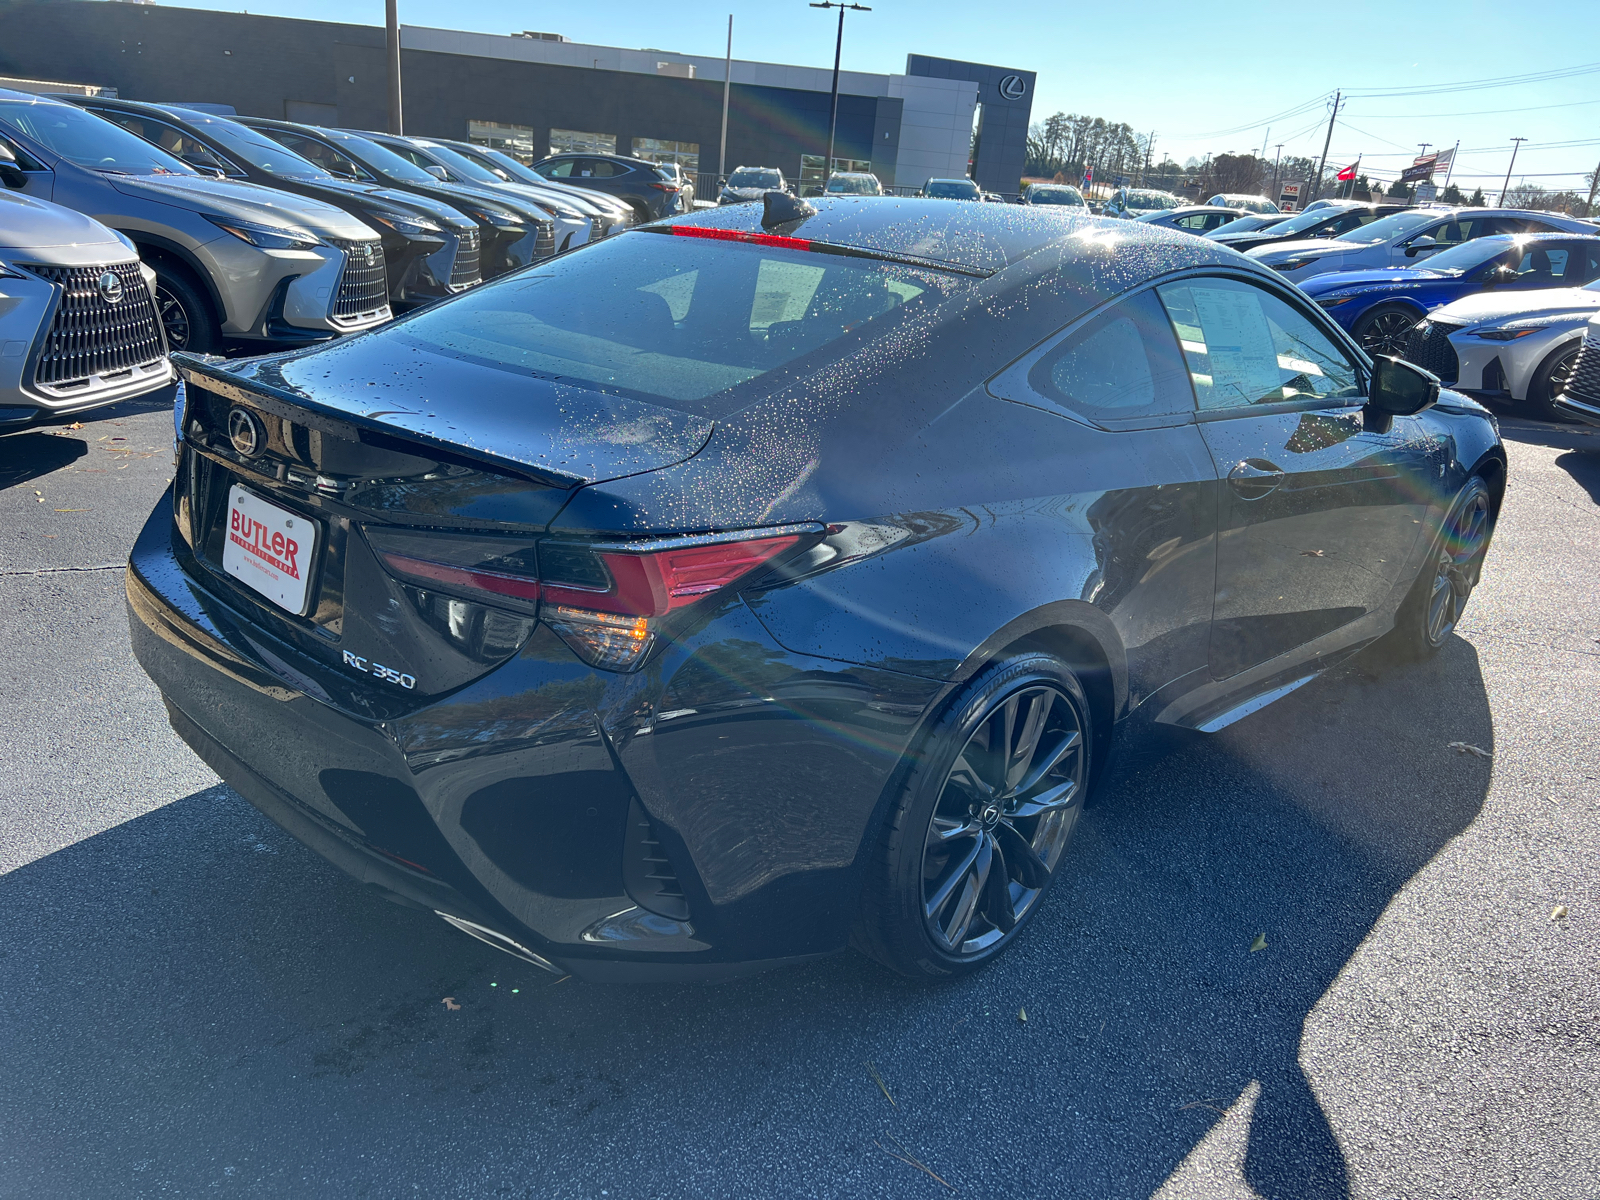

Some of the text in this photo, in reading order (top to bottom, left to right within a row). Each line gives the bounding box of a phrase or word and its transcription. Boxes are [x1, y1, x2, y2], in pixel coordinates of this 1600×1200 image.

[274, 559, 298, 577] GROUP
[342, 649, 416, 689] RC 350
[982, 659, 1060, 697] BRIDGESTONE
